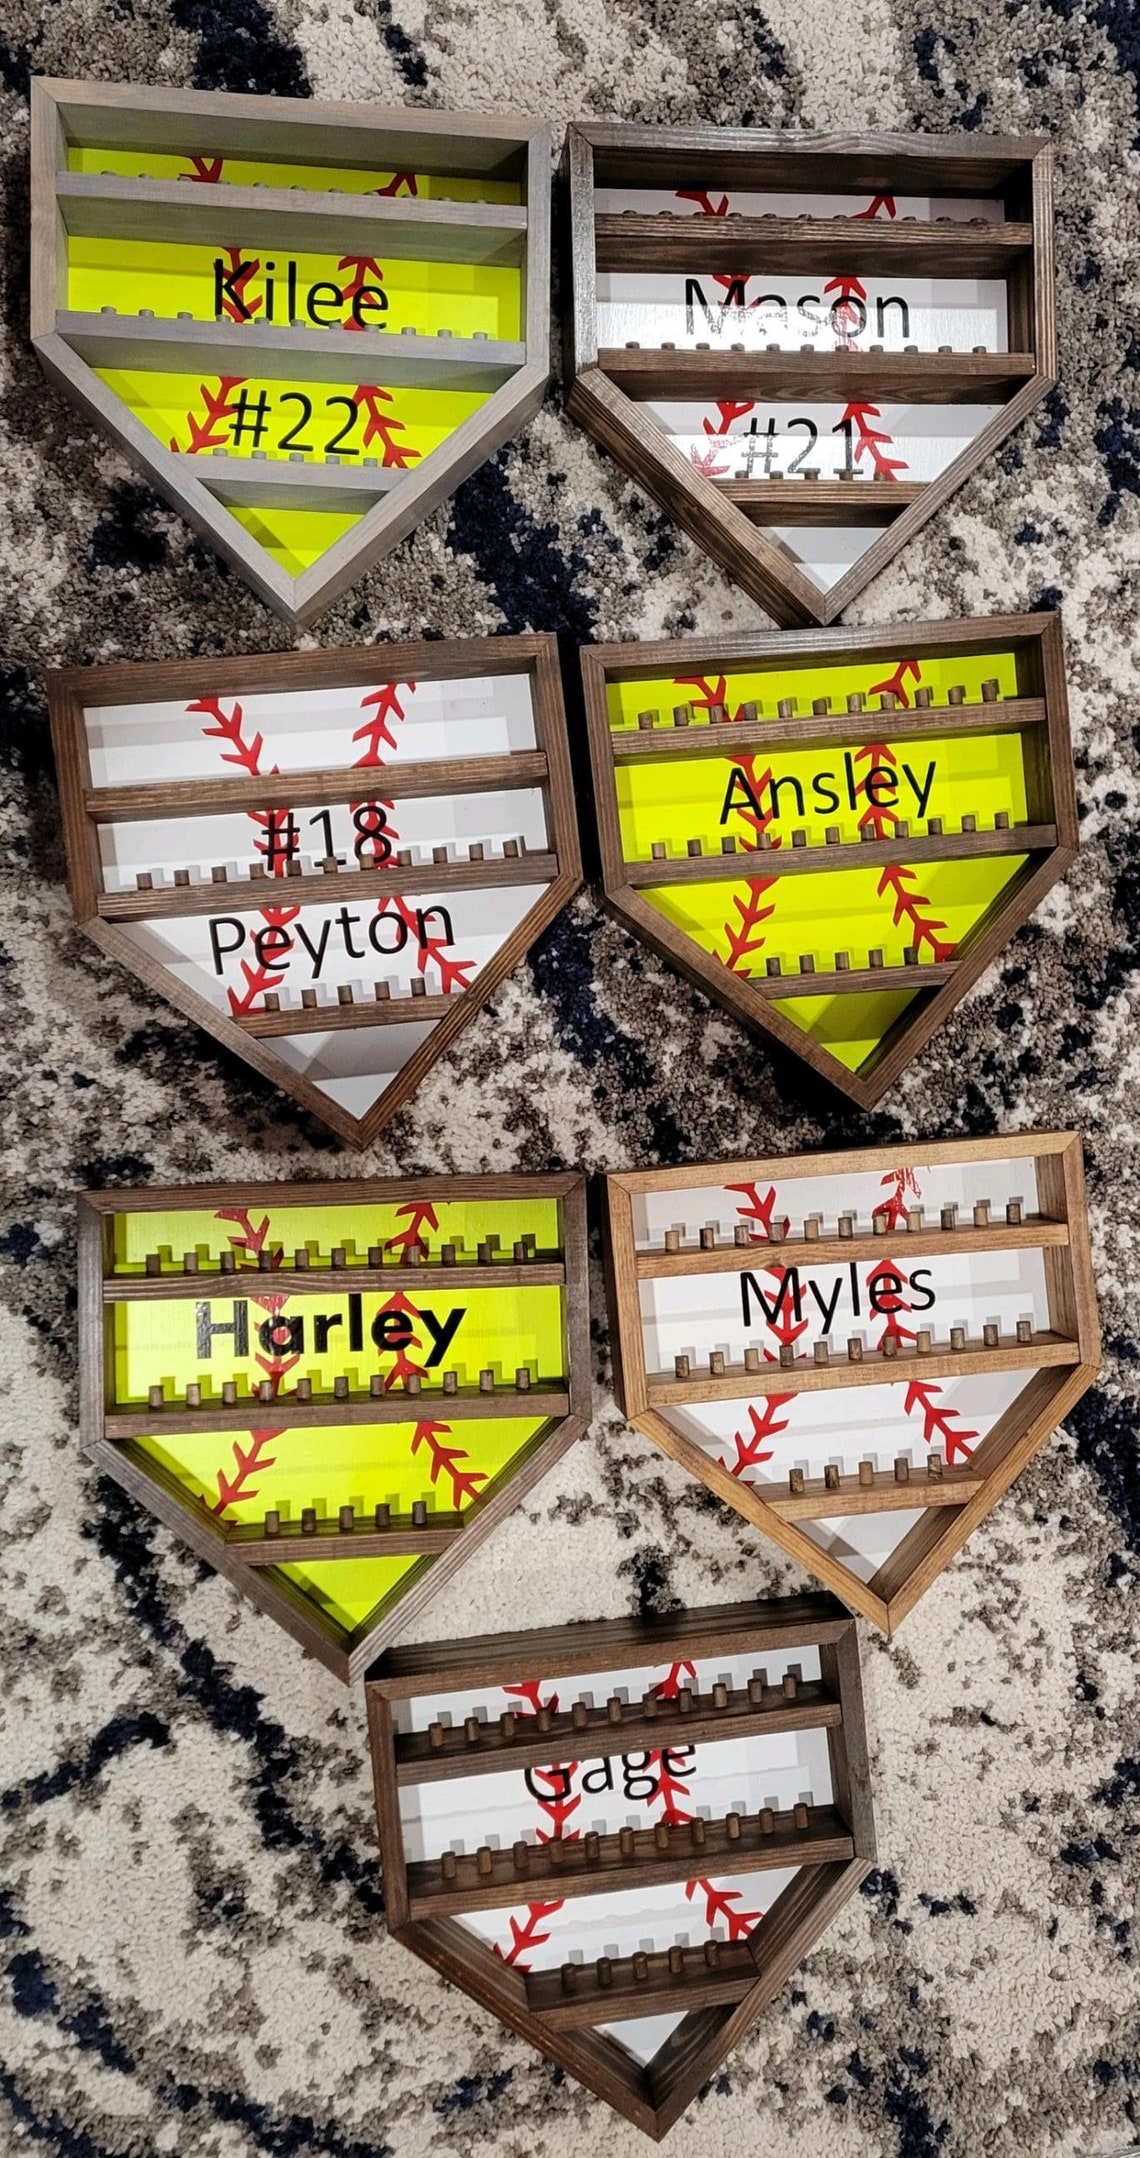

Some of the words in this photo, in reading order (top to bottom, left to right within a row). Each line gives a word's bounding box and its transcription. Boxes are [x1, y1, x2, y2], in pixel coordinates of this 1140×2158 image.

[214, 258, 389, 330] Kilee
[229, 388, 361, 455] #22
[742, 417, 864, 474] #21
[719, 751, 937, 825] Ansley
[261, 805, 392, 872] #18
[209, 903, 456, 978] Peyton
[195, 1292, 467, 1368] Harley
[739, 1262, 936, 1335] Myles
[524, 1744, 697, 1802] Gage
